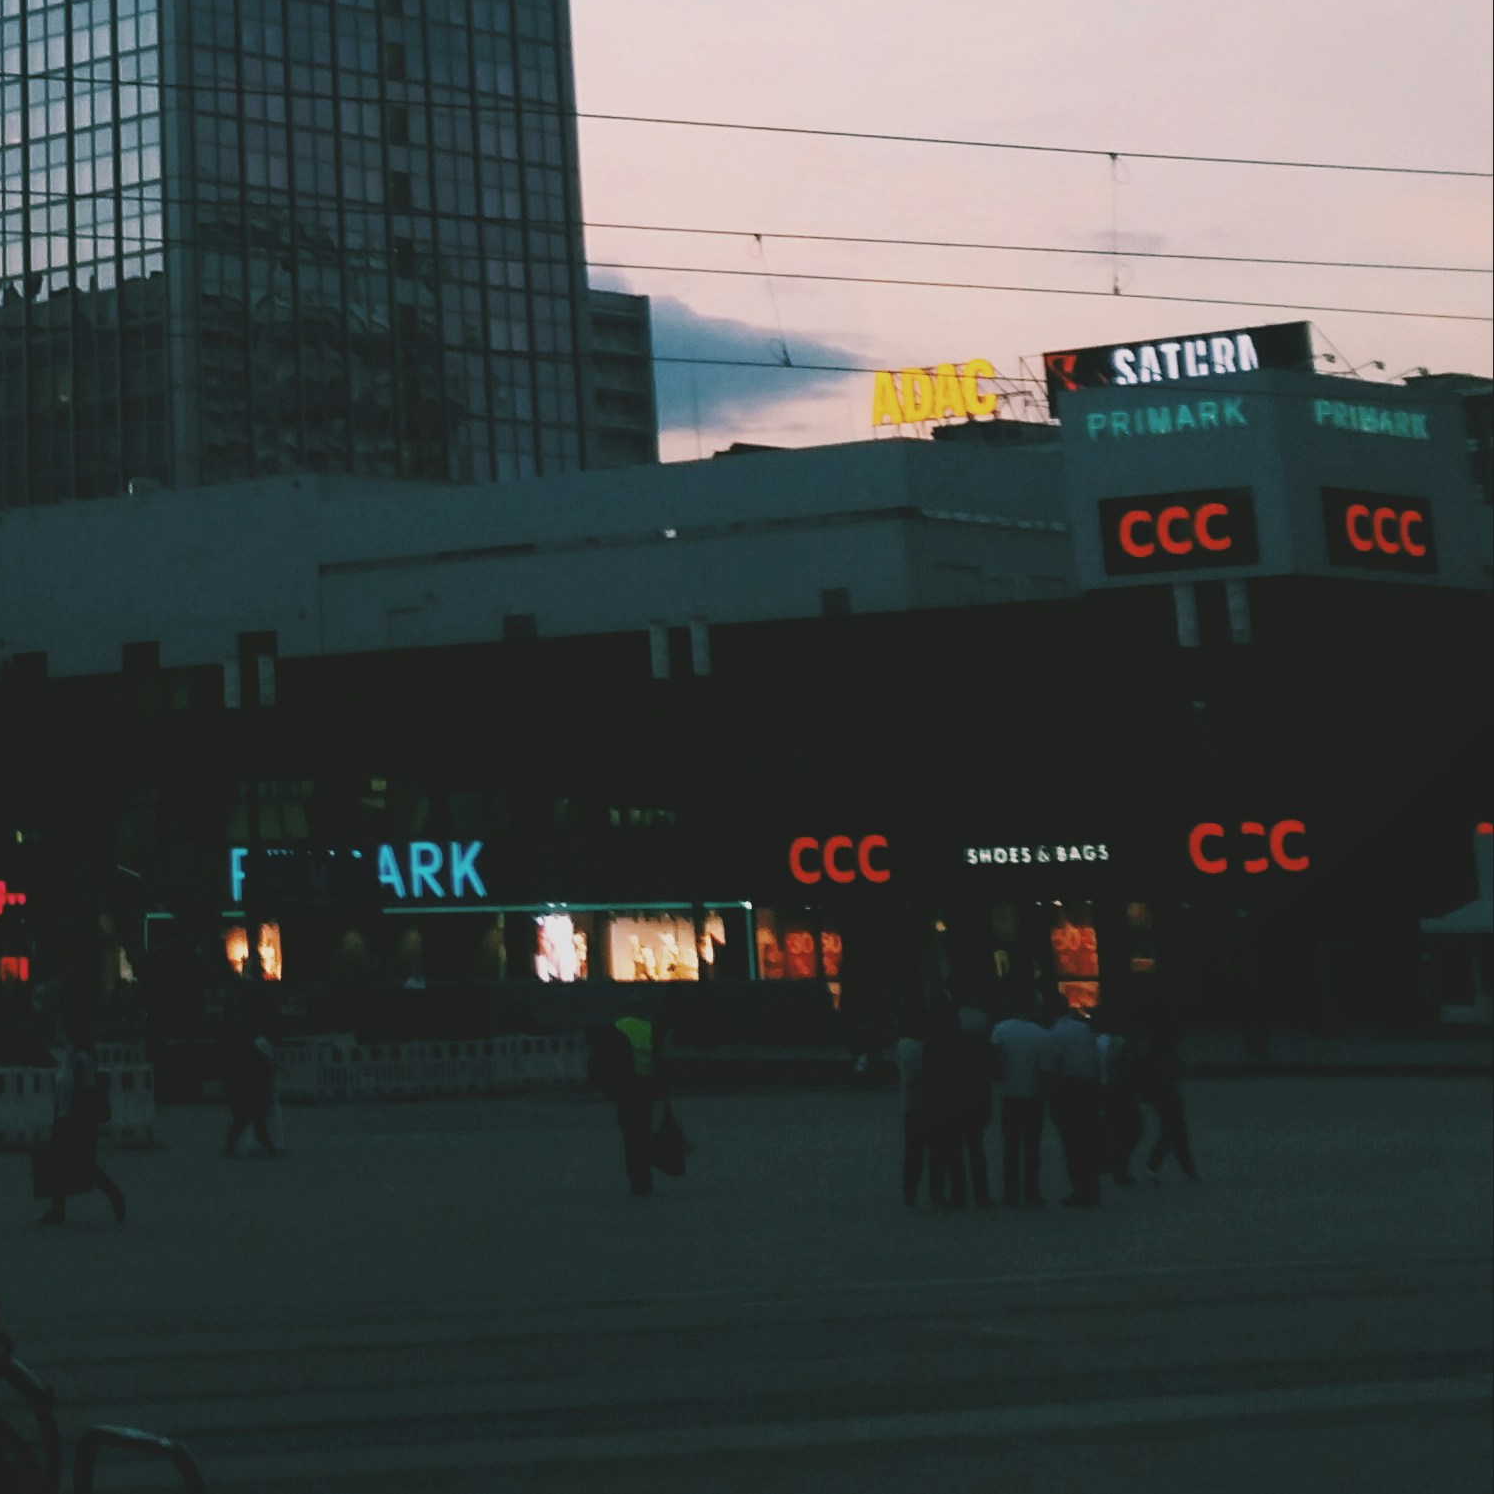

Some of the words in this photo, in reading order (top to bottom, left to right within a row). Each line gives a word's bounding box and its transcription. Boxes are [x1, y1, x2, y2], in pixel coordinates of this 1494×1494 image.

[872, 359, 998, 425] ADAC
[1085, 396, 1249, 441] PRIMARK
[1314, 398, 1432, 440] PRIMARK
[1119, 502, 1233, 558] CCC
[1346, 504, 1427, 556] CCC
[789, 834, 891, 884] CCC
[966, 846, 1032, 864] SHOES
[1037, 846, 1051, 862] &
[1055, 844, 1110, 862] BAGS
